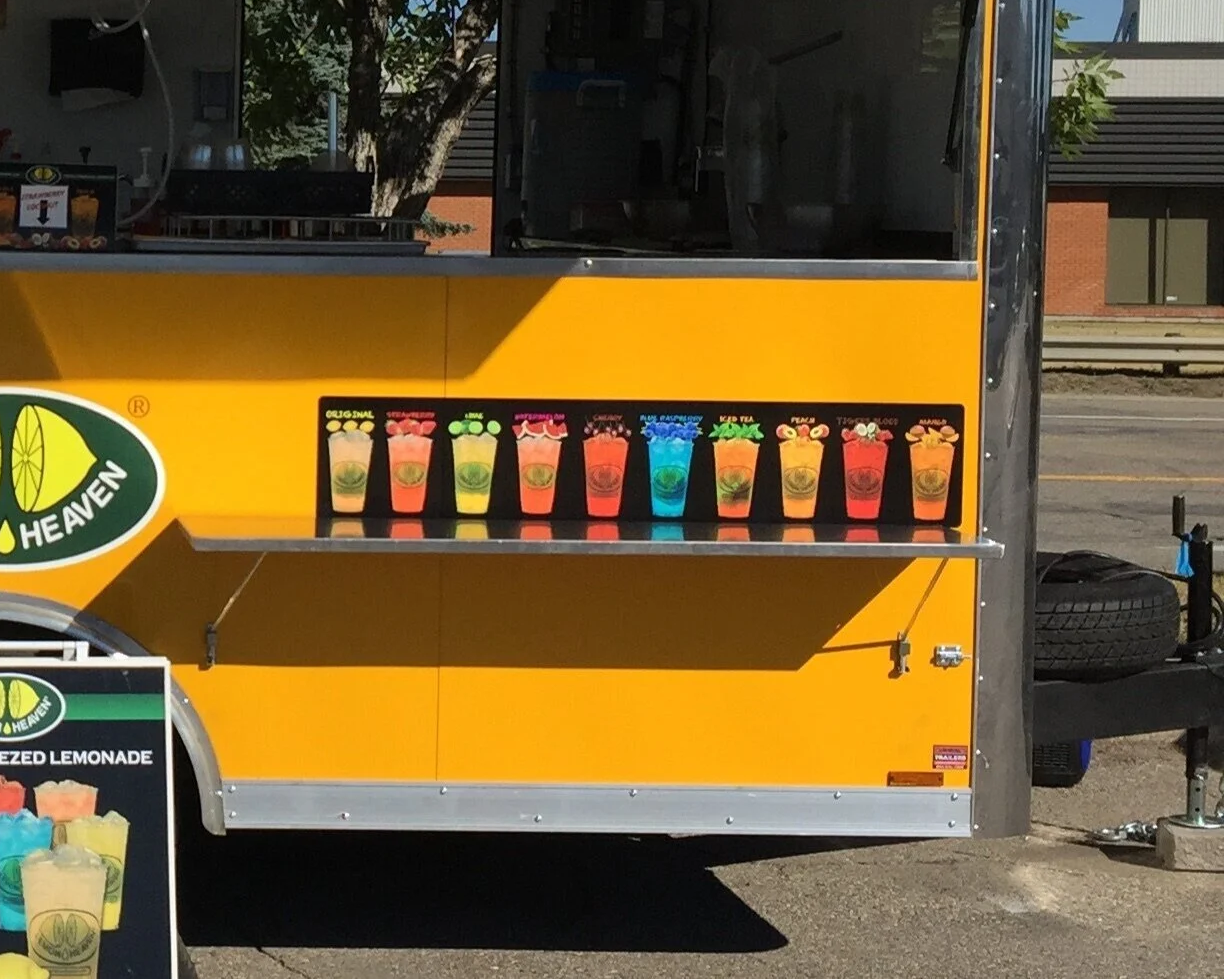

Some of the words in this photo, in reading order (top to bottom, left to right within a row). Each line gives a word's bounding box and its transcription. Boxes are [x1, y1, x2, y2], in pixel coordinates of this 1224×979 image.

[325, 410, 375, 419] ORIGINAL
[20, 460, 128, 550] HEAVEN
[12, 696, 52, 733] HEAVEN
[50, 750, 153, 765] LEMONADE
